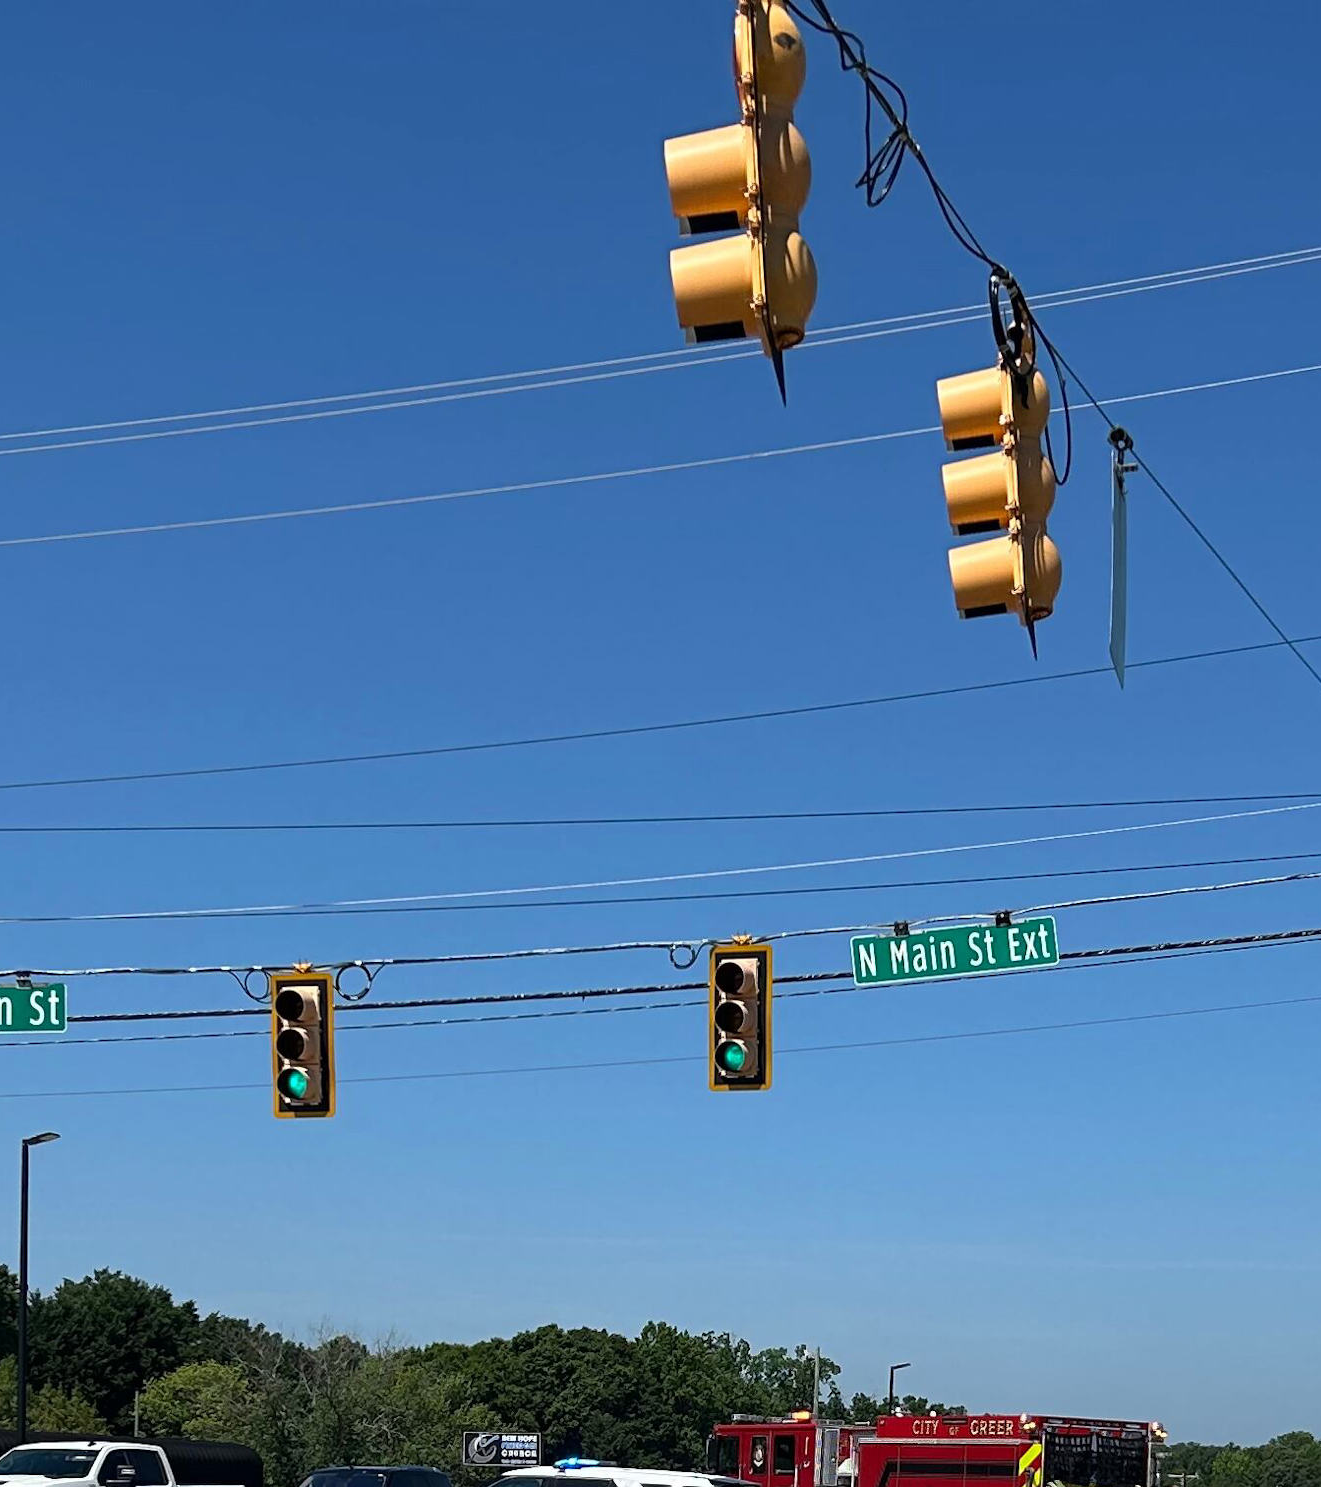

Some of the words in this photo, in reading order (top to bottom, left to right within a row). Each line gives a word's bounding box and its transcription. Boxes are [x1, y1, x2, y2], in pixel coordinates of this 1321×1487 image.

[858, 942, 877, 978] N
[889, 936, 956, 975] Main
[968, 930, 997, 967] St
[1008, 923, 1051, 962] Ext
[29, 990, 60, 1026] St
[913, 1420, 939, 1435] CITY
[970, 1420, 1014, 1436] GREER
